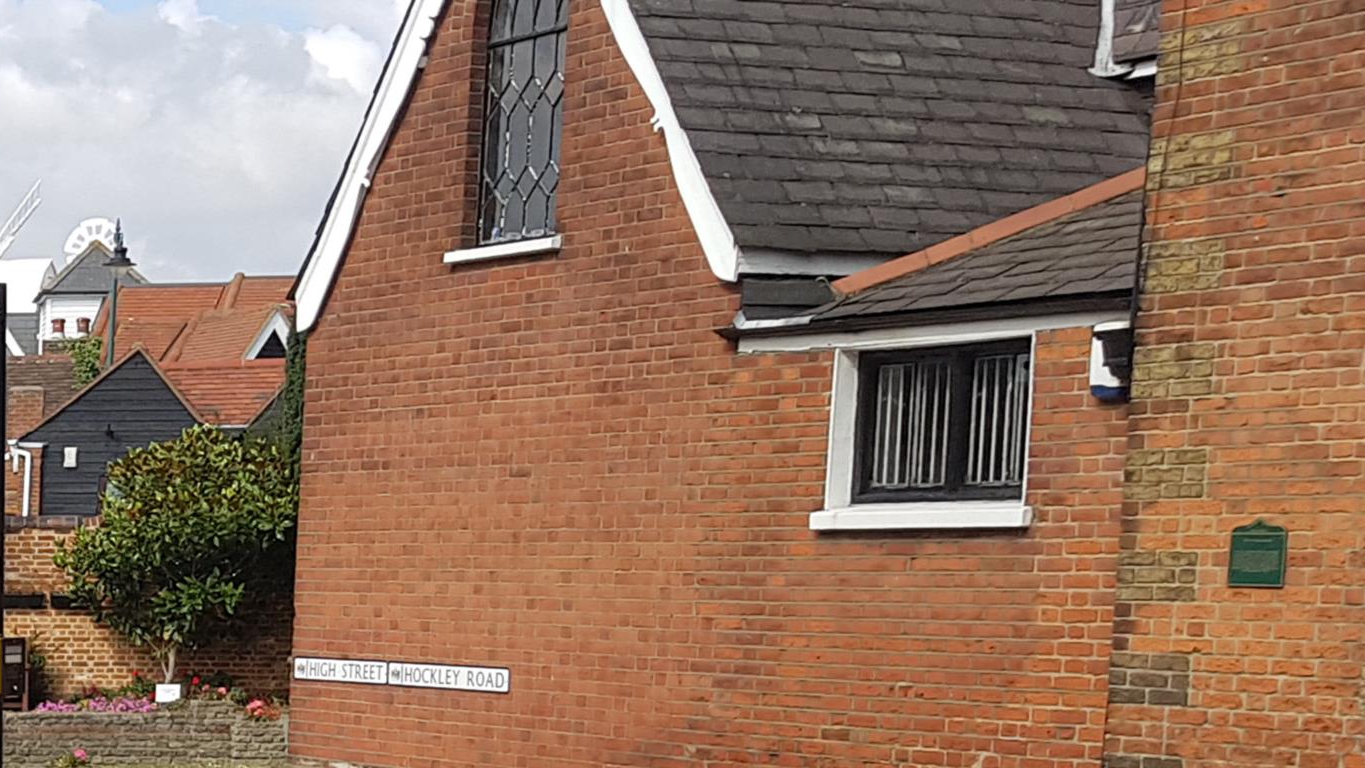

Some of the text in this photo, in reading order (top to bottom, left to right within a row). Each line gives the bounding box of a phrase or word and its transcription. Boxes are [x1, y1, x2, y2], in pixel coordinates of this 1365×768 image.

[308, 661, 383, 681] HIGH STREET
[404, 669, 505, 688] HOCKLEY ROAD
